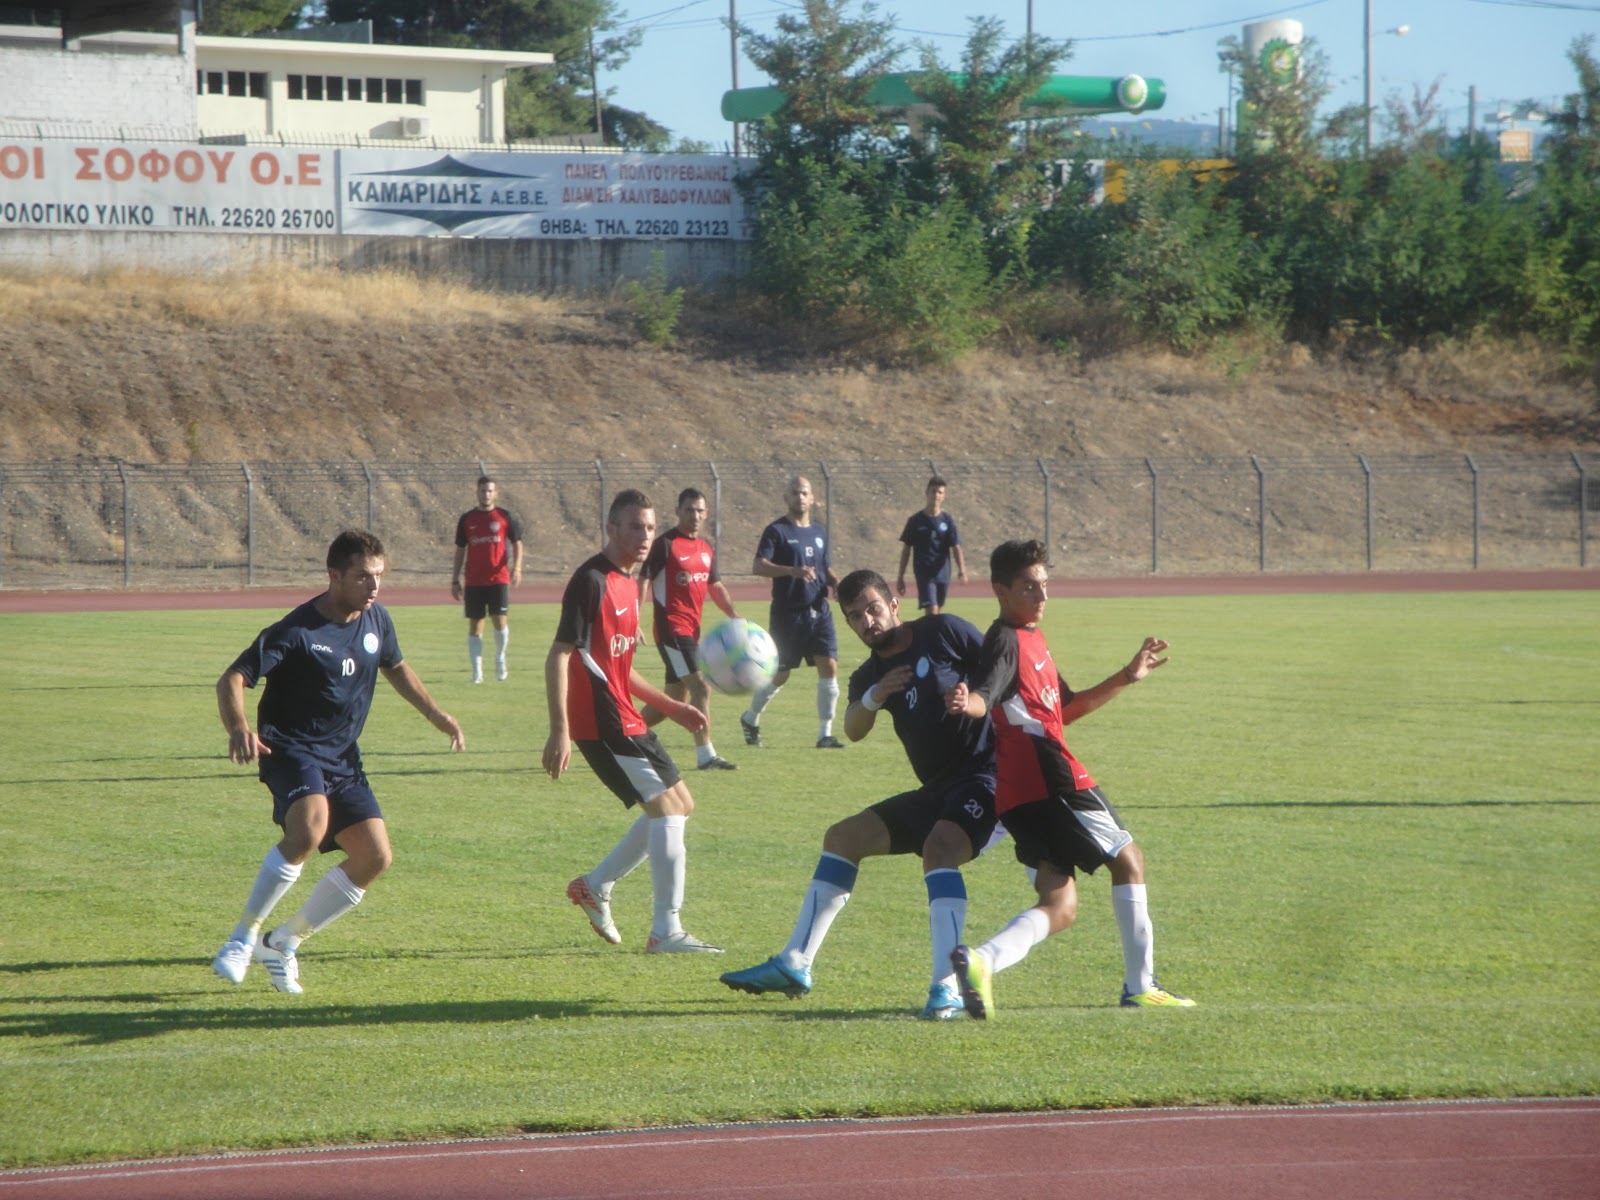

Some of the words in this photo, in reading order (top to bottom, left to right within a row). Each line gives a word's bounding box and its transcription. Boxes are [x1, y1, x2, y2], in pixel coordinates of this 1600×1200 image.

[74, 147, 236, 184] ΣΟΦΟΥ
[250, 153, 322, 186] Ο.Ε
[565, 163, 608, 180] ΠΑΝΕΛ
[348, 181, 482, 205] ΚΑΜΑΡΙΔΗΣ
[490, 190, 548, 206] Α.Ε.Β.Ε.
[0, 202, 89, 225] ΟΛΟΓΙΚΟ
[97, 204, 154, 226] ΥΛΙΚΟ
[173, 206, 216, 227] ΤΗΛ.
[221, 207, 276, 229] 22620
[281, 208, 335, 229] 26700
[540, 218, 588, 235] ΘΗΒΑ:
[595, 218, 631, 235] ΤΗΛ.
[635, 218, 679, 236] 22620
[685, 219, 729, 236] 23123
[341, 657, 355, 677] 10
[905, 686, 918, 710] 20
[963, 798, 985, 820] 20
